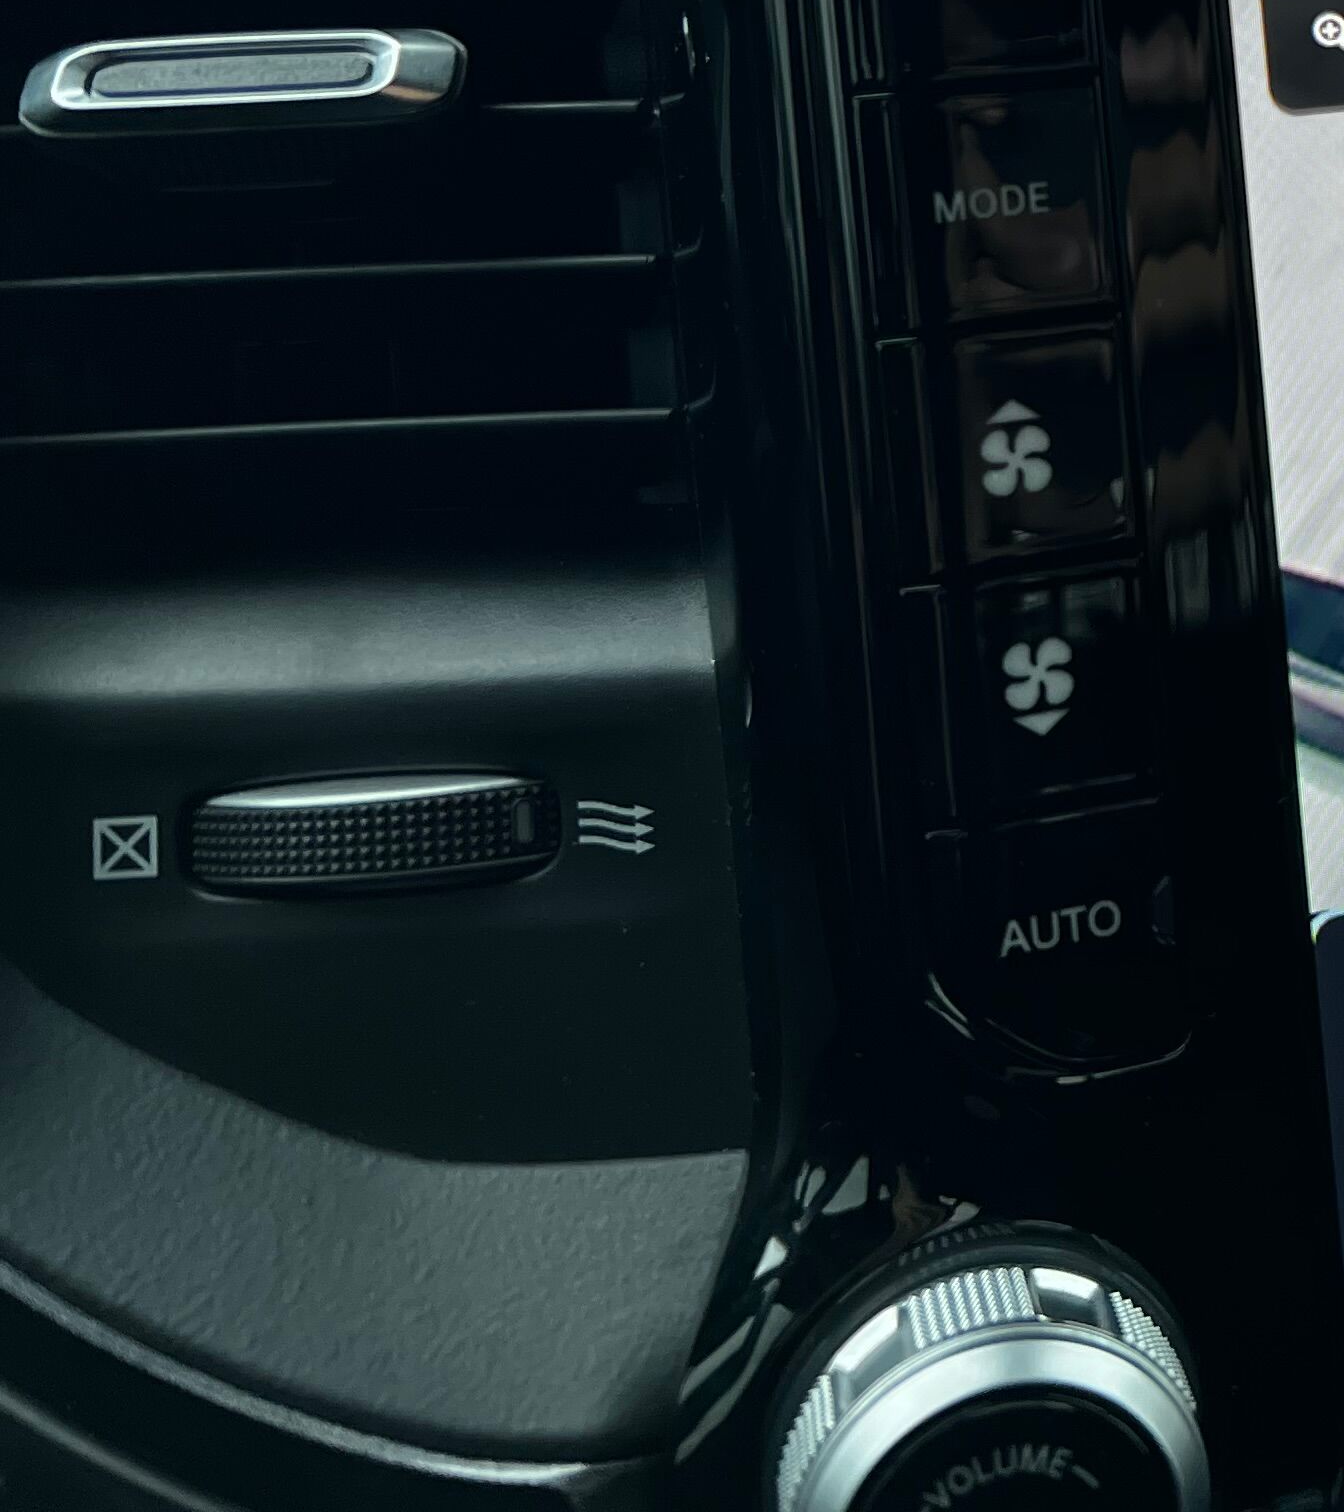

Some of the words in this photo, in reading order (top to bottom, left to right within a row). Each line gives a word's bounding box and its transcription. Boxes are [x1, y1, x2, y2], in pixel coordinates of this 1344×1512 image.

[933, 181, 1050, 224] MODE
[1000, 899, 1122, 958] AUTO
[922, 1442, 1074, 1509] VOLUME
